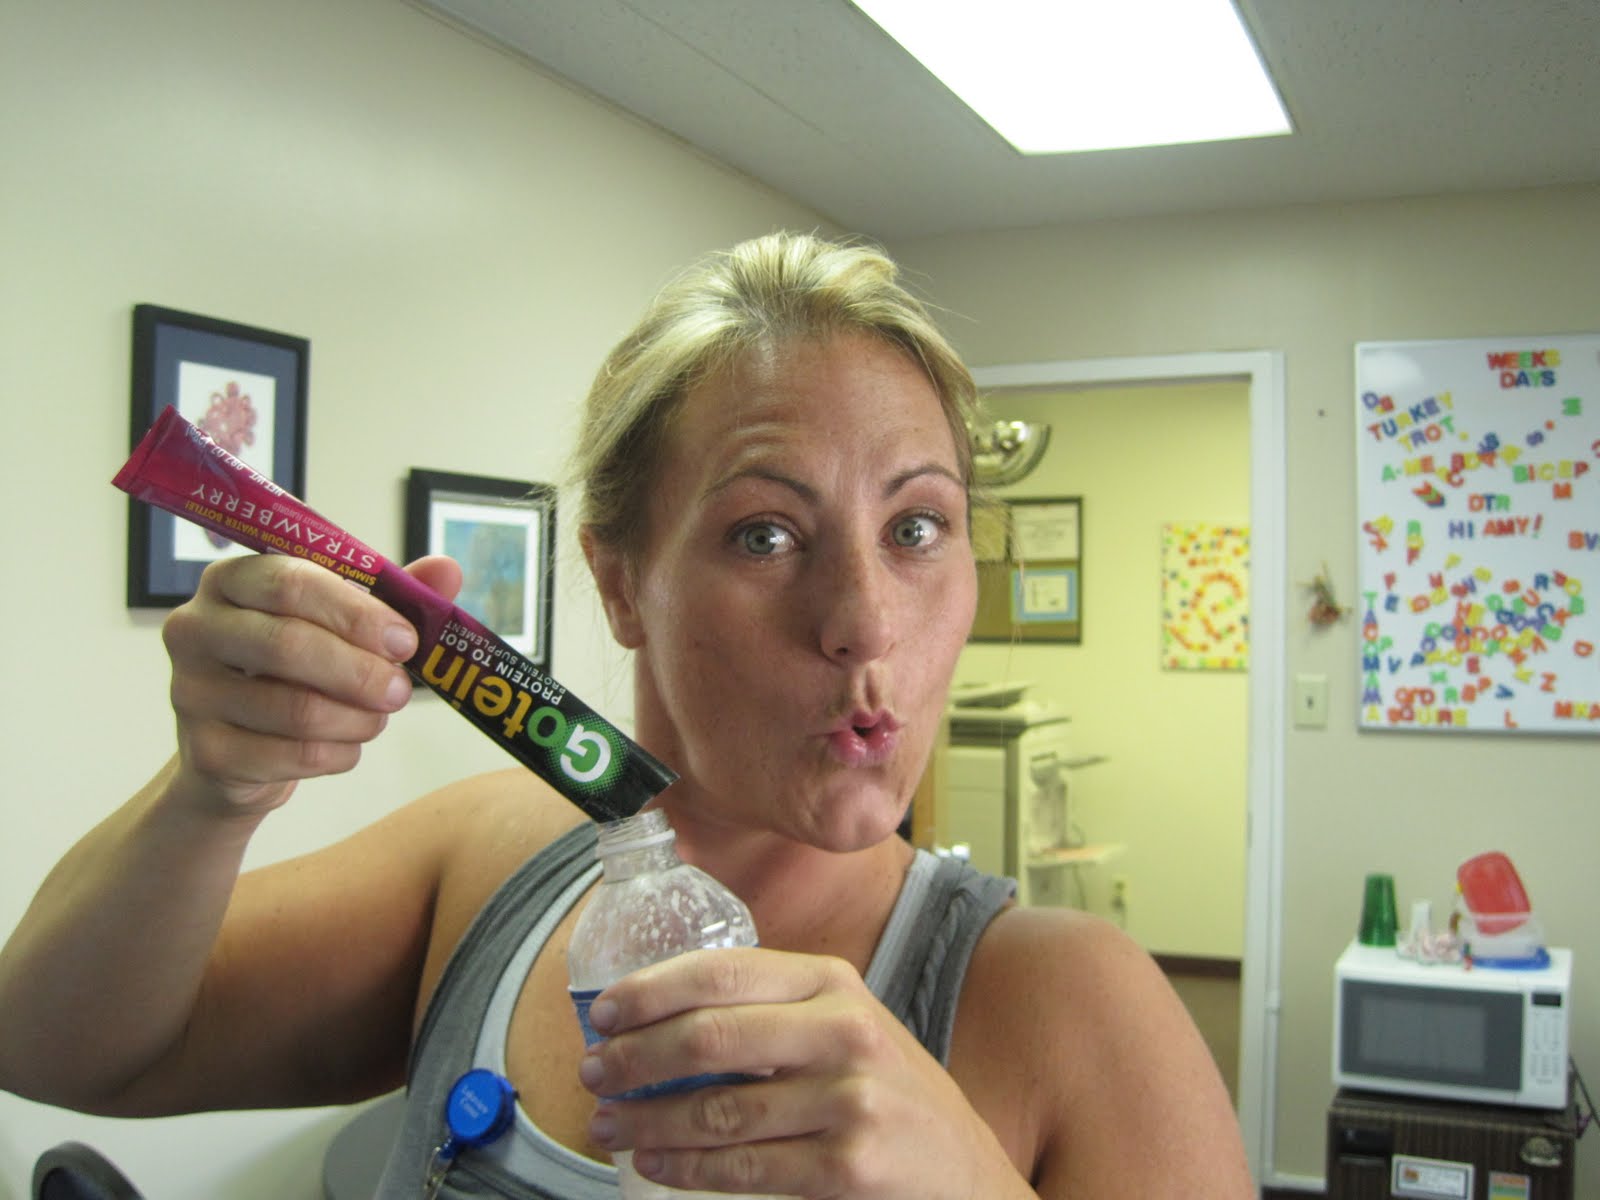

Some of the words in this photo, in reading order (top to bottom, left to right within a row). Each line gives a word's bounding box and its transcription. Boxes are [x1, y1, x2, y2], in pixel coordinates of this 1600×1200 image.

[1500, 370, 1556, 389] DAYS
[1397, 415, 1455, 453] TROT
[184, 500, 223, 523] BOTTLE!
[191, 483, 376, 570] STRAWBERRY
[225, 516, 259, 537] WATER
[1448, 521, 1474, 539] HI
[1483, 514, 1543, 538] AMY!
[261, 531, 291, 550] YOUR
[293, 544, 309, 558] TO
[311, 551, 337, 568] ADD
[336, 563, 377, 586] SIMPLY
[439, 629, 469, 653] GO!
[444, 619, 519, 665] SUPPLEMENT
[472, 648, 492, 668] TO
[495, 661, 563, 706] PROTEIN
[519, 661, 567, 695] PROTEIN
[421, 644, 611, 783] Gotein
